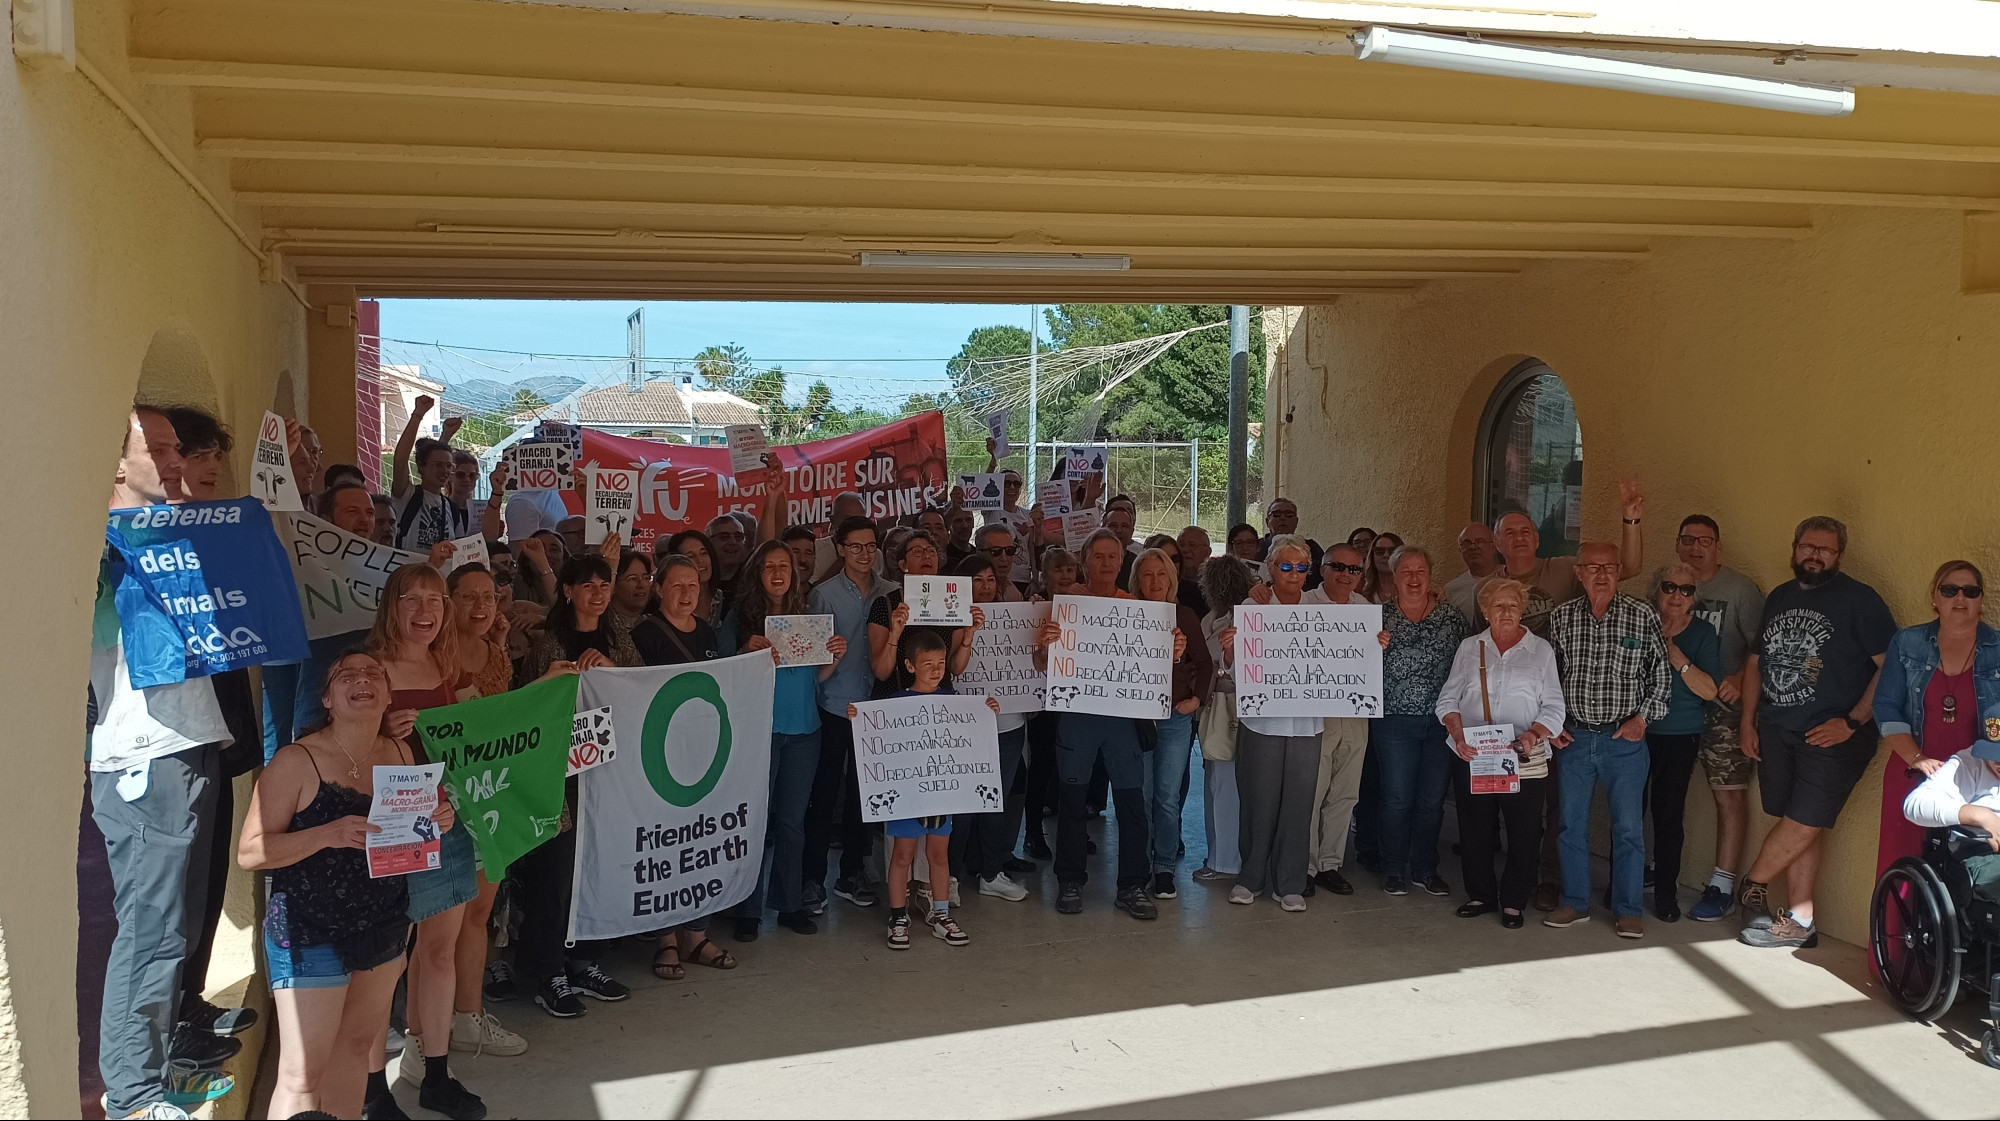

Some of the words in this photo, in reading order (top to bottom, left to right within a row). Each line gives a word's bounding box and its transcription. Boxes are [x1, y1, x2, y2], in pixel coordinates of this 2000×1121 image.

[261, 416, 279, 442] NO
[256, 447, 285, 467] TERRENO
[519, 447, 551, 458] MACRO
[519, 458, 555, 469] GRANJA
[1067, 459, 1089, 471] NO
[520, 469, 557, 488] NO
[595, 472, 630, 491] NO
[717, 461, 848, 499] MORTOIRE
[854, 457, 895, 487] SUR
[594, 490, 633, 499] RECALIFICACIÓN
[595, 497, 632, 510] TERRENO
[962, 498, 1001, 509] ONTAMINACIÓN
[131, 506, 242, 530] defensa
[139, 547, 201, 574] dels
[922, 582, 930, 593] SI
[946, 582, 957, 593] NO
[160, 587, 247, 616] imals
[992, 608, 1012, 620] LA
[1057, 603, 1078, 624] NO
[1108, 605, 1120, 617] A
[1126, 606, 1146, 619] LA
[1243, 611, 1263, 633] NO
[1288, 611, 1300, 622] A
[1305, 611, 1325, 622] LA
[1003, 618, 1047, 630] GRANJA
[1081, 614, 1128, 629] MACRO
[1132, 619, 1173, 632] GRANJA
[1263, 622, 1309, 633] MACRO
[1314, 622, 1367, 633] GRANJA
[975, 635, 986, 646] A
[994, 634, 1012, 645] LA
[1054, 629, 1077, 651] NO
[1106, 632, 1119, 644] A
[1125, 633, 1144, 646] LA
[1243, 637, 1263, 659] NO
[1288, 637, 1300, 648] A
[1306, 637, 1325, 648] LA
[1077, 641, 1170, 659] CONTAMINACIÓN
[1264, 644, 1365, 659] CONTAMINACIÓN
[975, 660, 986, 671] A
[995, 660, 1014, 670] LA
[1053, 656, 1075, 678] NO
[1104, 660, 1116, 671] A
[1122, 661, 1141, 673] LA
[1244, 663, 1264, 684] NO
[1287, 664, 1299, 675] A
[1306, 664, 1326, 674] LA
[1075, 667, 1169, 685] RECALIFICACION
[1264, 673, 1367, 685] RECALIFICACION
[995, 684, 1030, 696] SUELO
[1084, 684, 1109, 698] DEL
[1115, 688, 1155, 701] SUELO
[1273, 688, 1298, 699] DEL
[1303, 688, 1345, 700] SUELO
[1780, 693, 1797, 703] BUT
[1796, 685, 1816, 699] SEA
[862, 709, 887, 732] NO
[918, 705, 929, 715] A
[931, 704, 949, 715] LA
[886, 714, 929, 729] MACRO
[933, 713, 977, 725] GRANJA
[426, 721, 464, 741] POR
[463, 726, 541, 767] MUNDO
[861, 736, 885, 757] NO
[920, 729, 931, 740] A
[934, 728, 952, 739] LA
[884, 736, 972, 754] CONTAMINACIÓN
[863, 762, 886, 783] NO
[926, 755, 937, 766] A
[938, 754, 955, 764] LA
[975, 762, 994, 774] DEL
[388, 775, 397, 783] 17
[397, 775, 420, 783] MAYO
[918, 779, 960, 793] SUELO
[380, 793, 437, 806] MACRO-GRANJA
[397, 787, 424, 796] STOP
[635, 813, 717, 853] Friends
[720, 802, 748, 831] of
[633, 856, 672, 885] the
[679, 834, 748, 875] Earth
[632, 877, 723, 917] Europe
